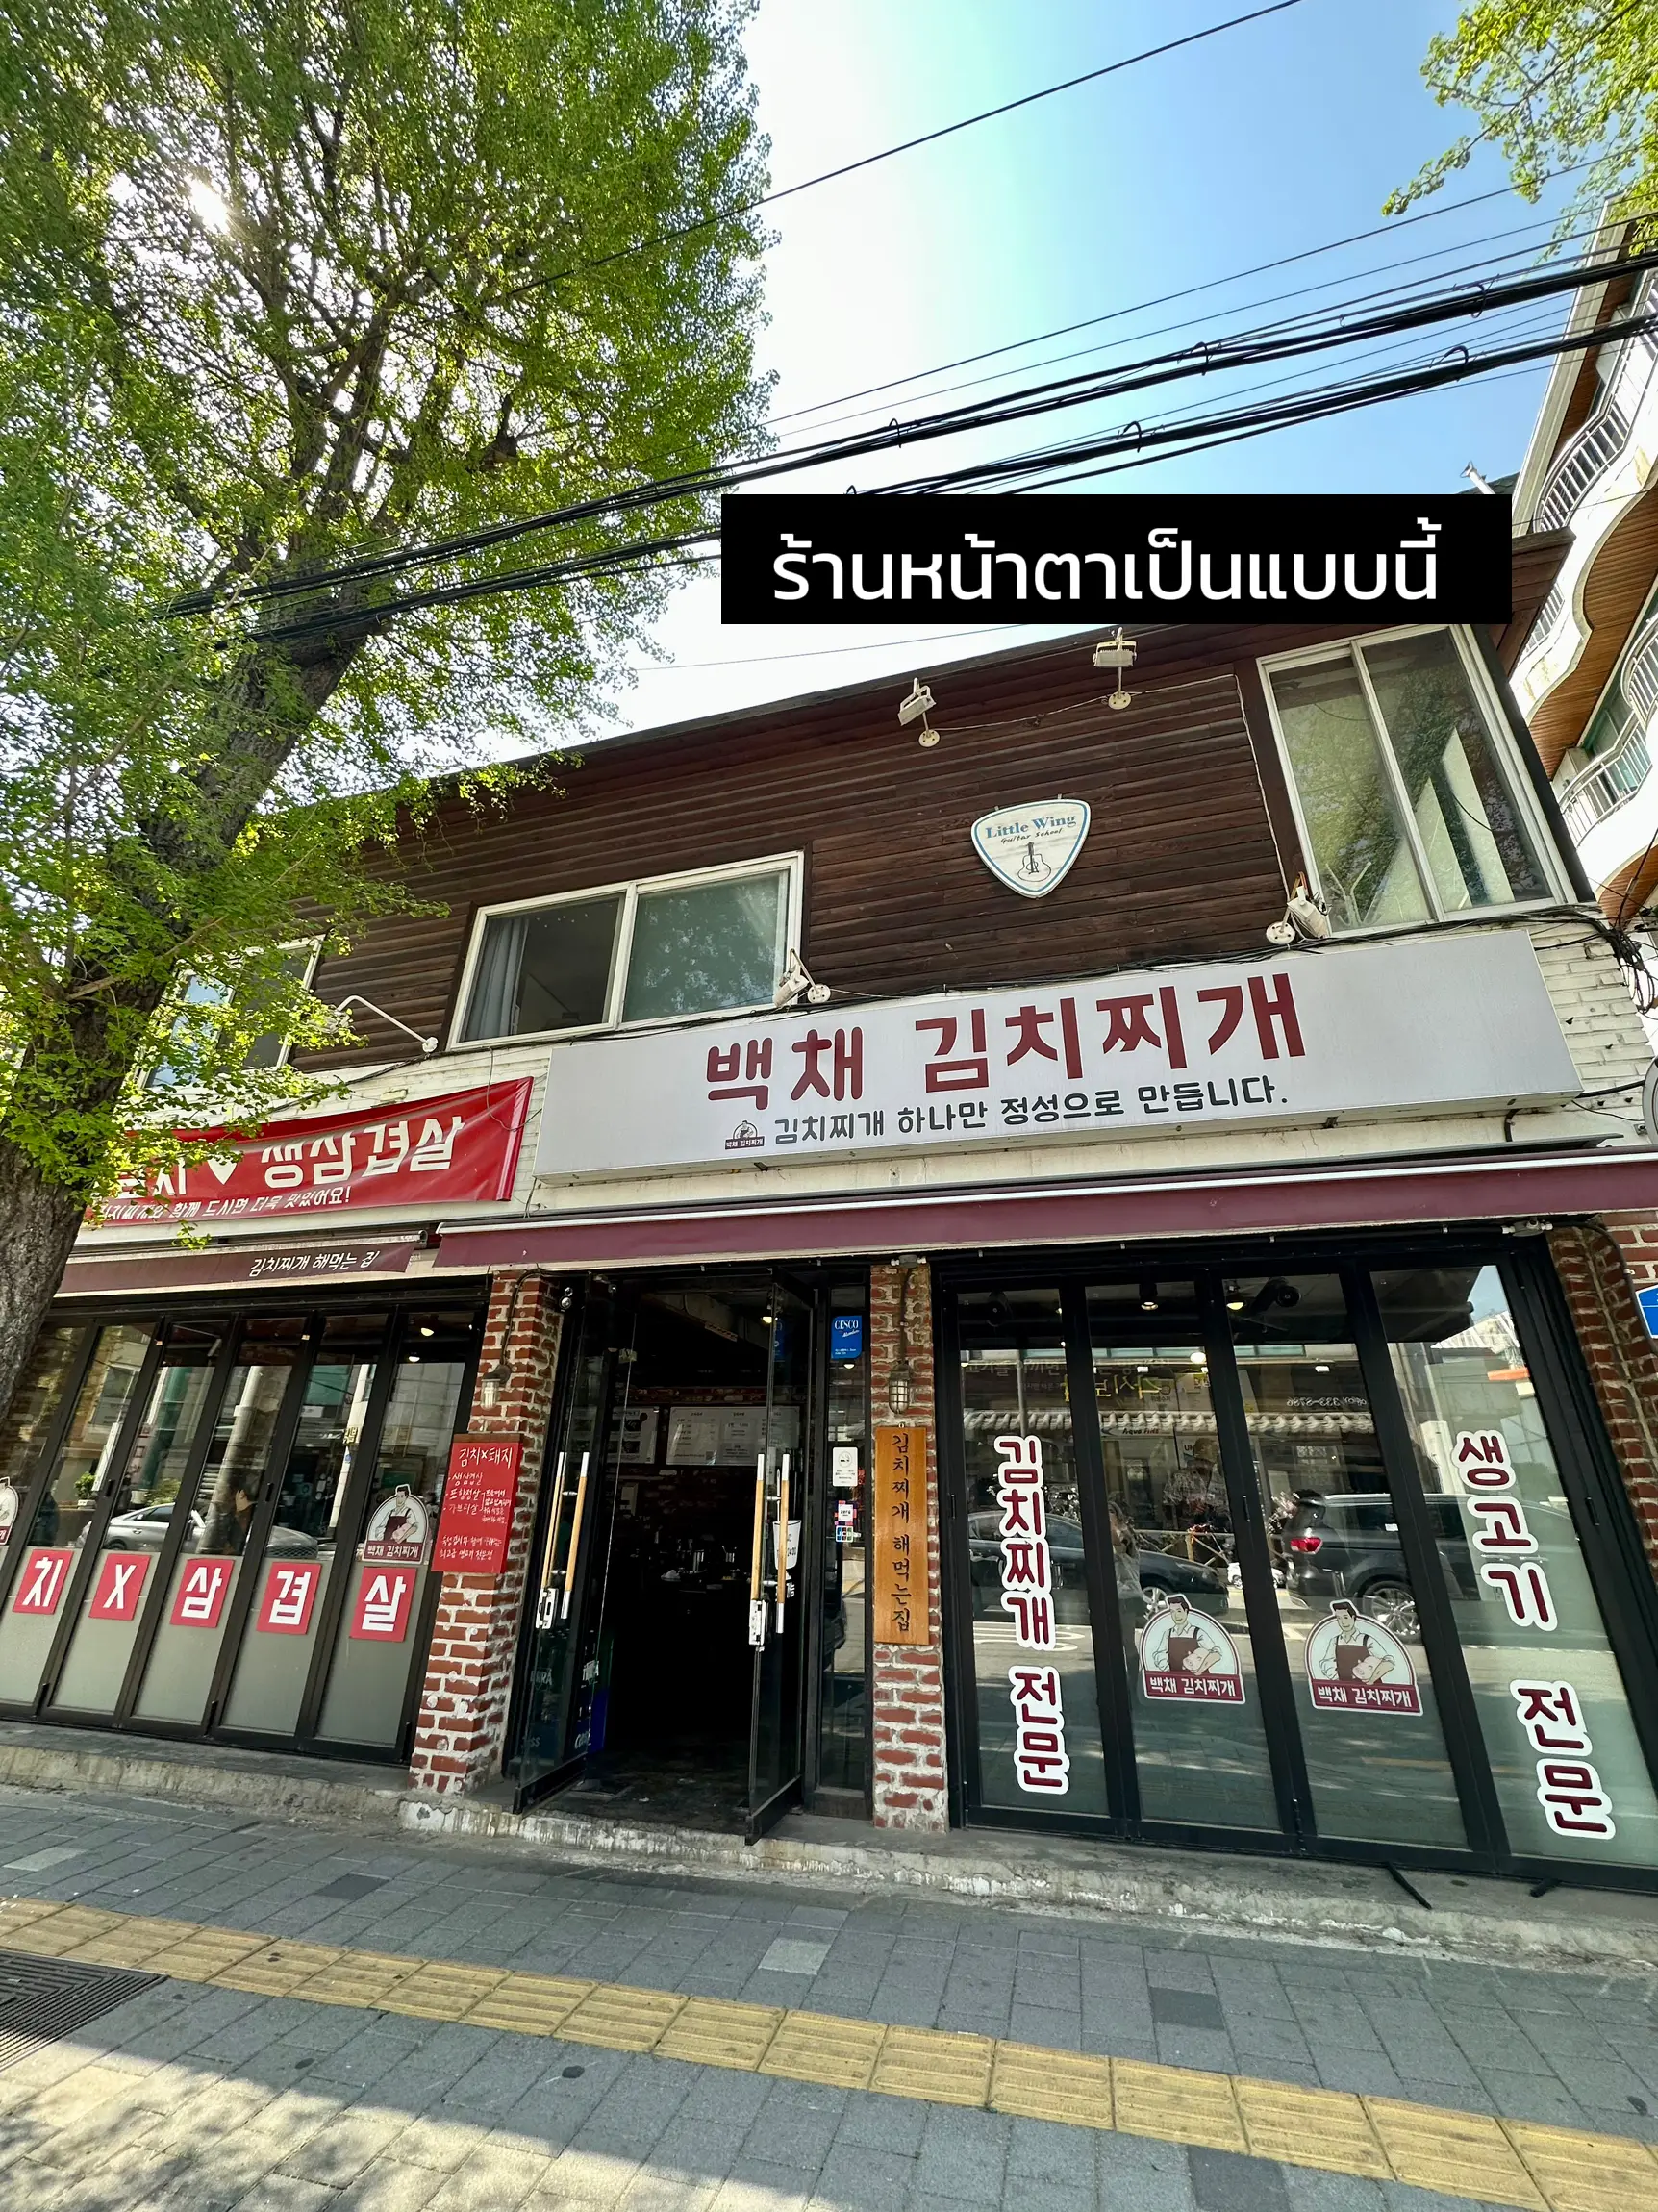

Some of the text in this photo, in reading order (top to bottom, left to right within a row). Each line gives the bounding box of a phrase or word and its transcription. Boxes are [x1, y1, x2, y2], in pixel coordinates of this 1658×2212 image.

[985, 816, 1076, 839] Little Wing
[1000, 828, 1063, 844] Guitar School
[915, 972, 1305, 1093] 김치찌개
[774, 1074, 1289, 1144] 김치찌개 하나만 정성으로 만듭니다.
[261, 1116, 465, 1190] 생삼겹살
[168, 1201, 202, 1219] 함께
[201, 1197, 250, 1217] 드시면
[249, 1194, 283, 1211] 더욱
[283, 1185, 353, 1209] 맛있어요!
[249, 1250, 381, 1277] 김치찌개 해먹는 집
[835, 1320, 859, 1330] CESCO
[891, 1432, 910, 1525] 김치찌개
[448, 1502, 480, 1516] 가브리살
[367, 1545, 419, 1558] 백채 김치찌개
[997, 1439, 1051, 1646] 김치찌개
[21, 1555, 60, 1608] 치
[1457, 1433, 1609, 1834] 생고기 전문
[1149, 1676, 1236, 1697] 백채 김치찌개
[1317, 1686, 1413, 1708] 백채 김치찌개
[1012, 1671, 1065, 1789] 전문
